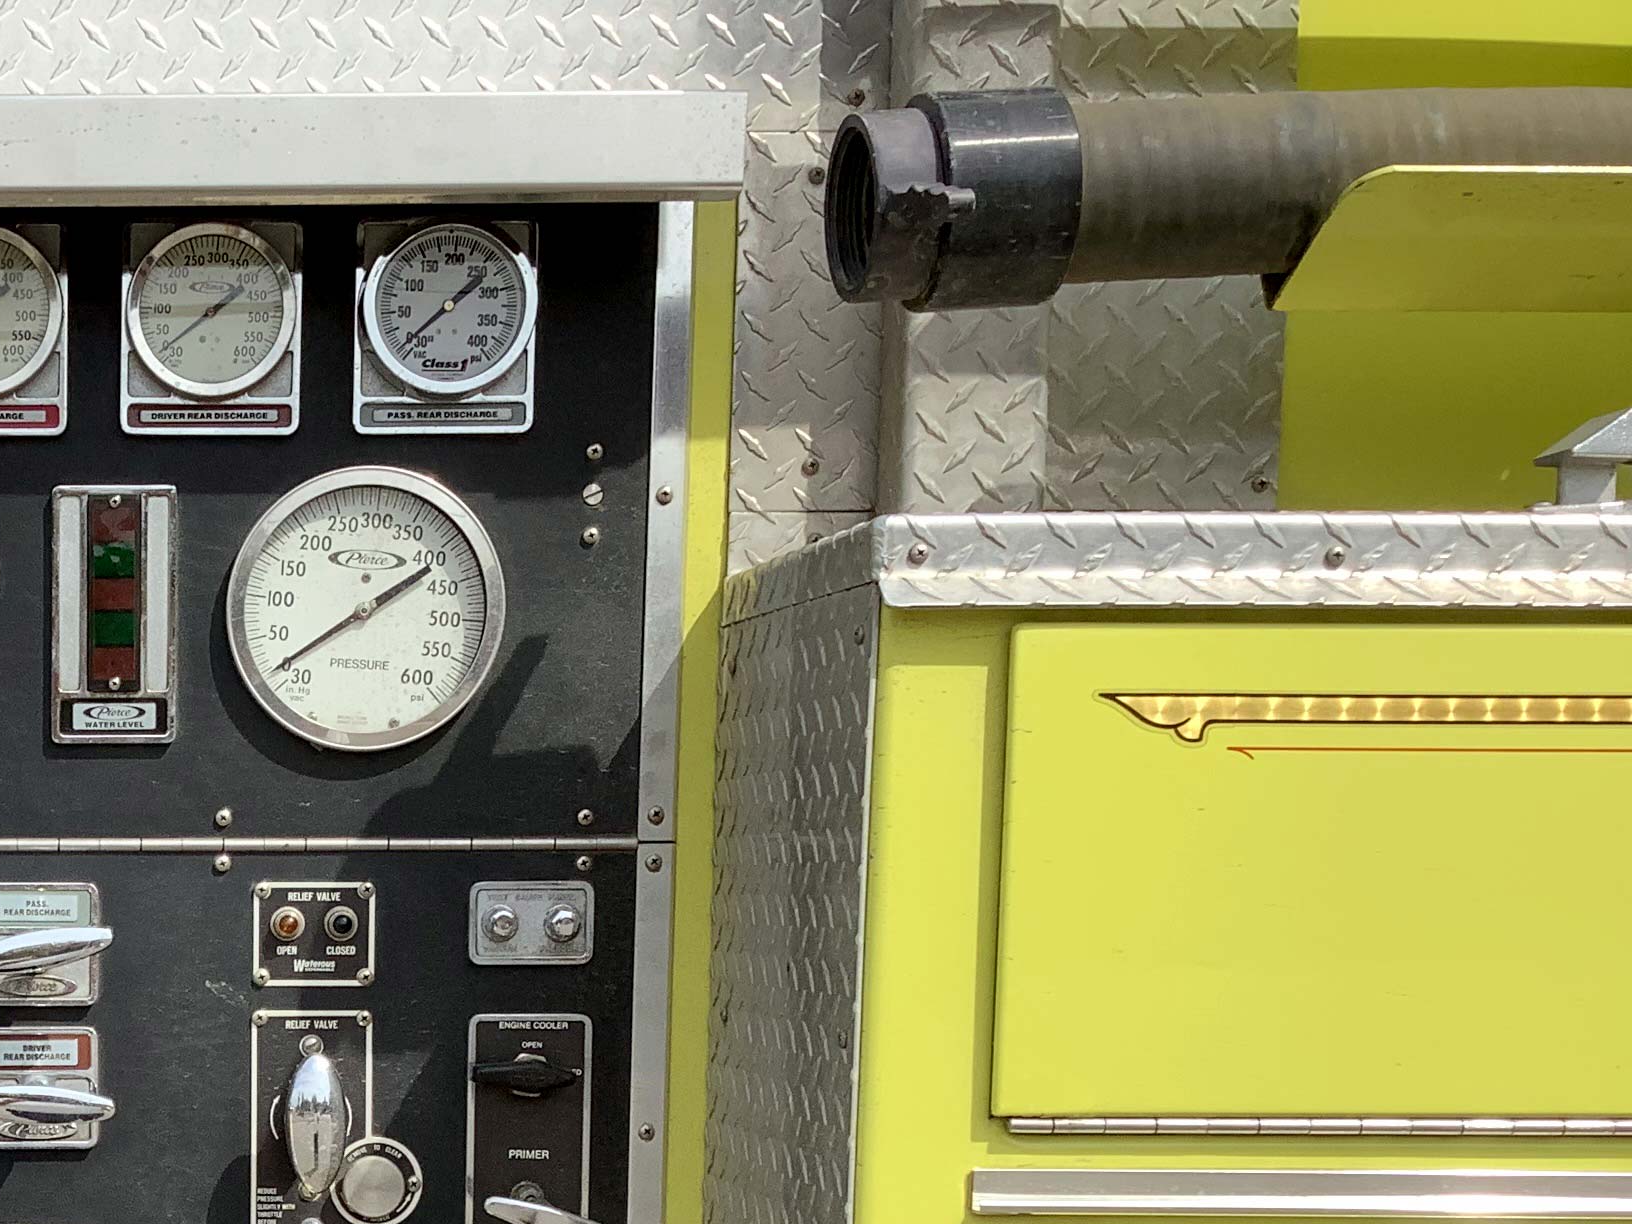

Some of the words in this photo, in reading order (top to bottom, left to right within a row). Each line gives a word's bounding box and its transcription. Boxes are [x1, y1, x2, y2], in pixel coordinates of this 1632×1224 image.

[478, 287, 498, 298] 300
[444, 410, 498, 418] DISCHARGE
[328, 515, 358, 532] 250
[361, 512, 393, 529] 300
[392, 524, 423, 541] 350
[300, 534, 332, 551] 200
[345, 552, 389, 566] Pierce
[412, 550, 445, 567] 400
[280, 561, 306, 577] 150
[427, 580, 458, 596] 450
[268, 592, 294, 607] 100
[428, 611, 461, 628] 500
[269, 625, 289, 641] 50
[421, 642, 451, 658] 550
[330, 658, 389, 671] PRESSURE
[290, 669, 311, 685] 30
[400, 669, 433, 686] 600
[410, 694, 424, 703] psi
[97, 706, 131, 718] Pierce
[116, 720, 144, 728] LEVEL
[287, 892, 314, 901] RELIEF
[316, 892, 341, 901] VALVE
[25, 900, 48, 908] PASS.
[276, 946, 297, 955] OPEN
[326, 946, 356, 955] CLOSED
[293, 959, 336, 972] Waterous
[285, 1020, 310, 1029] RELIEF
[313, 1020, 338, 1029] VALVE
[499, 1021, 531, 1030] ENGINE
[532, 1021, 569, 1030] COOLER
[521, 1041, 543, 1049] OPEN
[508, 1149, 550, 1160] PRIMER
